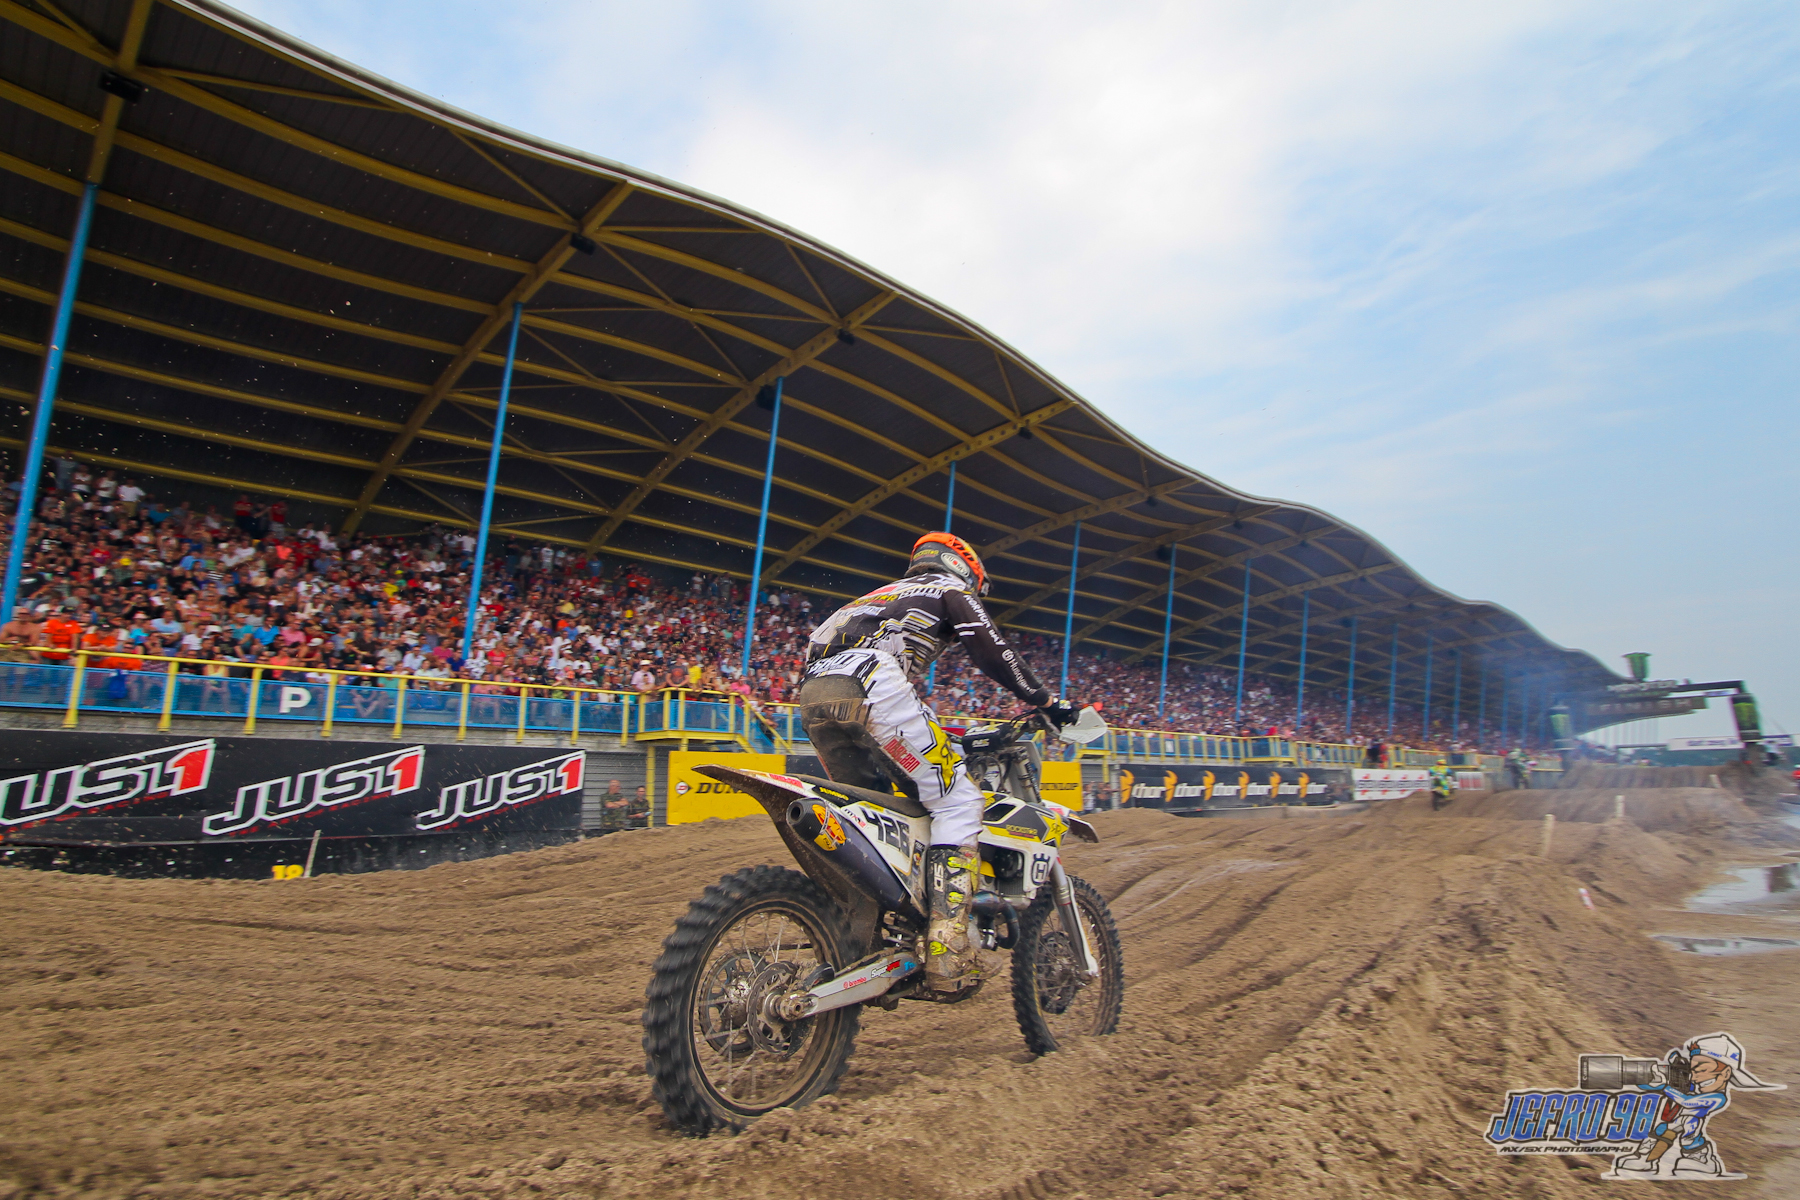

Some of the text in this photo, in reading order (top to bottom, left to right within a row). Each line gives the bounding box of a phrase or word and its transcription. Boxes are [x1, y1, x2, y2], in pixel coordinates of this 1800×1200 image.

[279, 687, 312, 714] P
[0, 738, 216, 826] UST1
[202, 745, 425, 836] JUST1
[416, 750, 587, 830] JUST1
[696, 782, 748, 794] DUN
